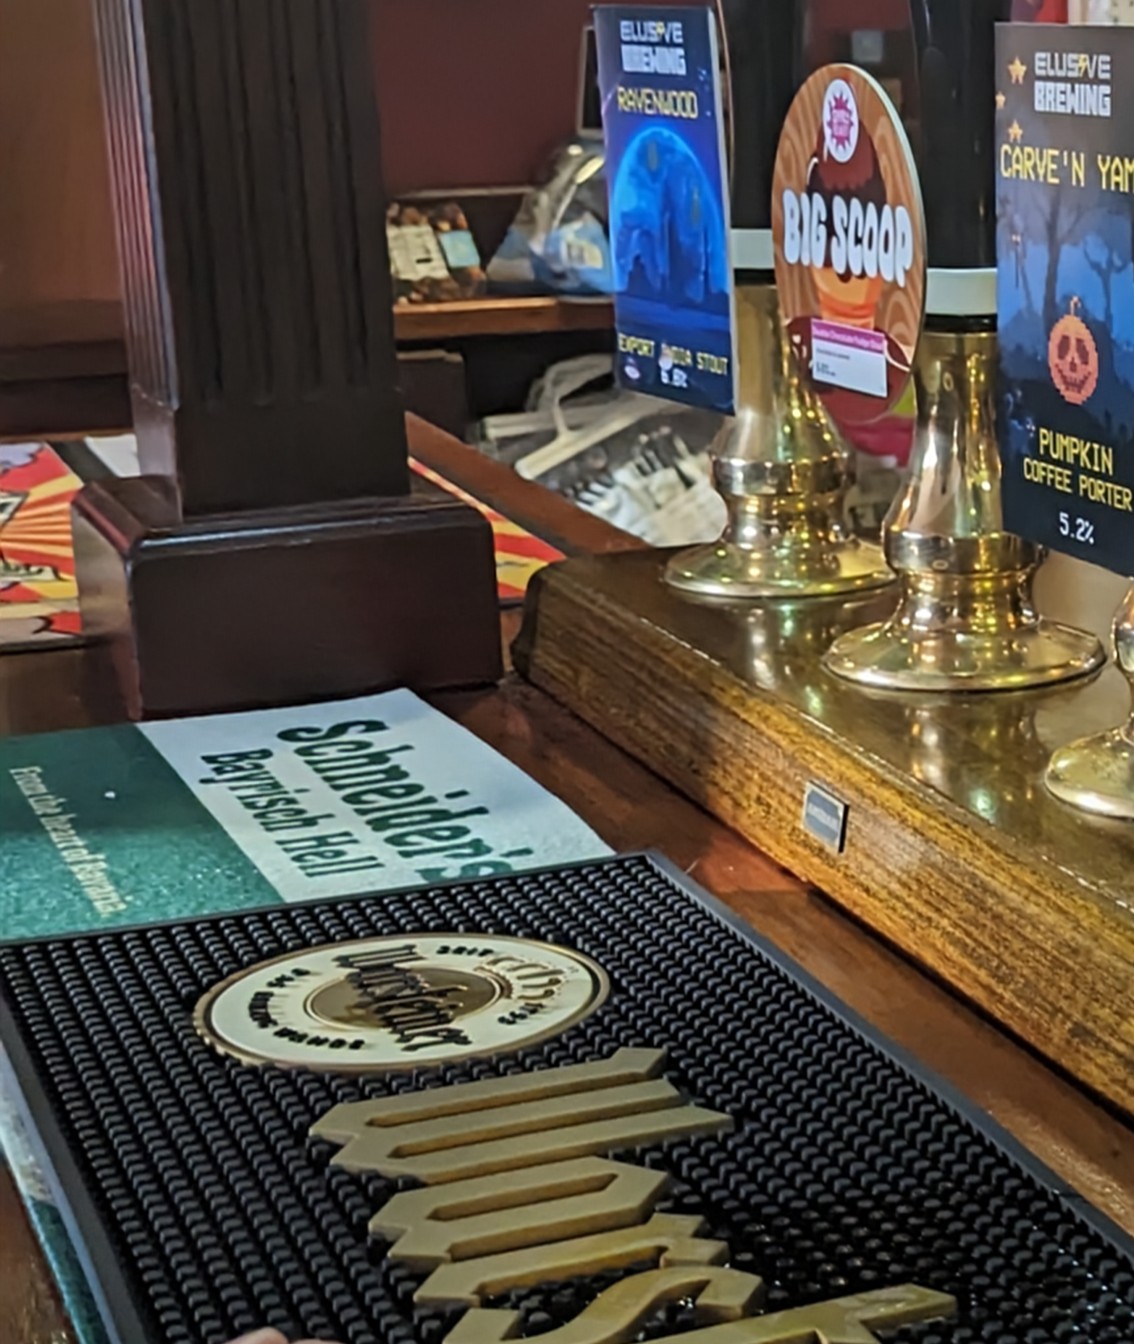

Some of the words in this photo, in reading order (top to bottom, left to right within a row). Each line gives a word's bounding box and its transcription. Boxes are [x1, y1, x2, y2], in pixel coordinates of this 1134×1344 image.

[1034, 52, 1111, 79] ELUSIVE
[617, 86, 698, 120] RAVENWOOD
[1034, 80, 1111, 117] BREWING
[1000, 144, 1085, 187] CARVE'N
[782, 187, 827, 266] BIG
[831, 192, 914, 287] SCOOP
[1039, 428, 1114, 476] PUMPKIN
[1024, 458, 1073, 493] COFFEE
[1079, 474, 1133, 512] PORTER
[1059, 512, 1095, 544] 5.2%
[9, 766, 49, 796] From
[276, 719, 534, 885] Schneider's
[199, 748, 336, 833] Bayrisch
[275, 831, 386, 878] Hell
